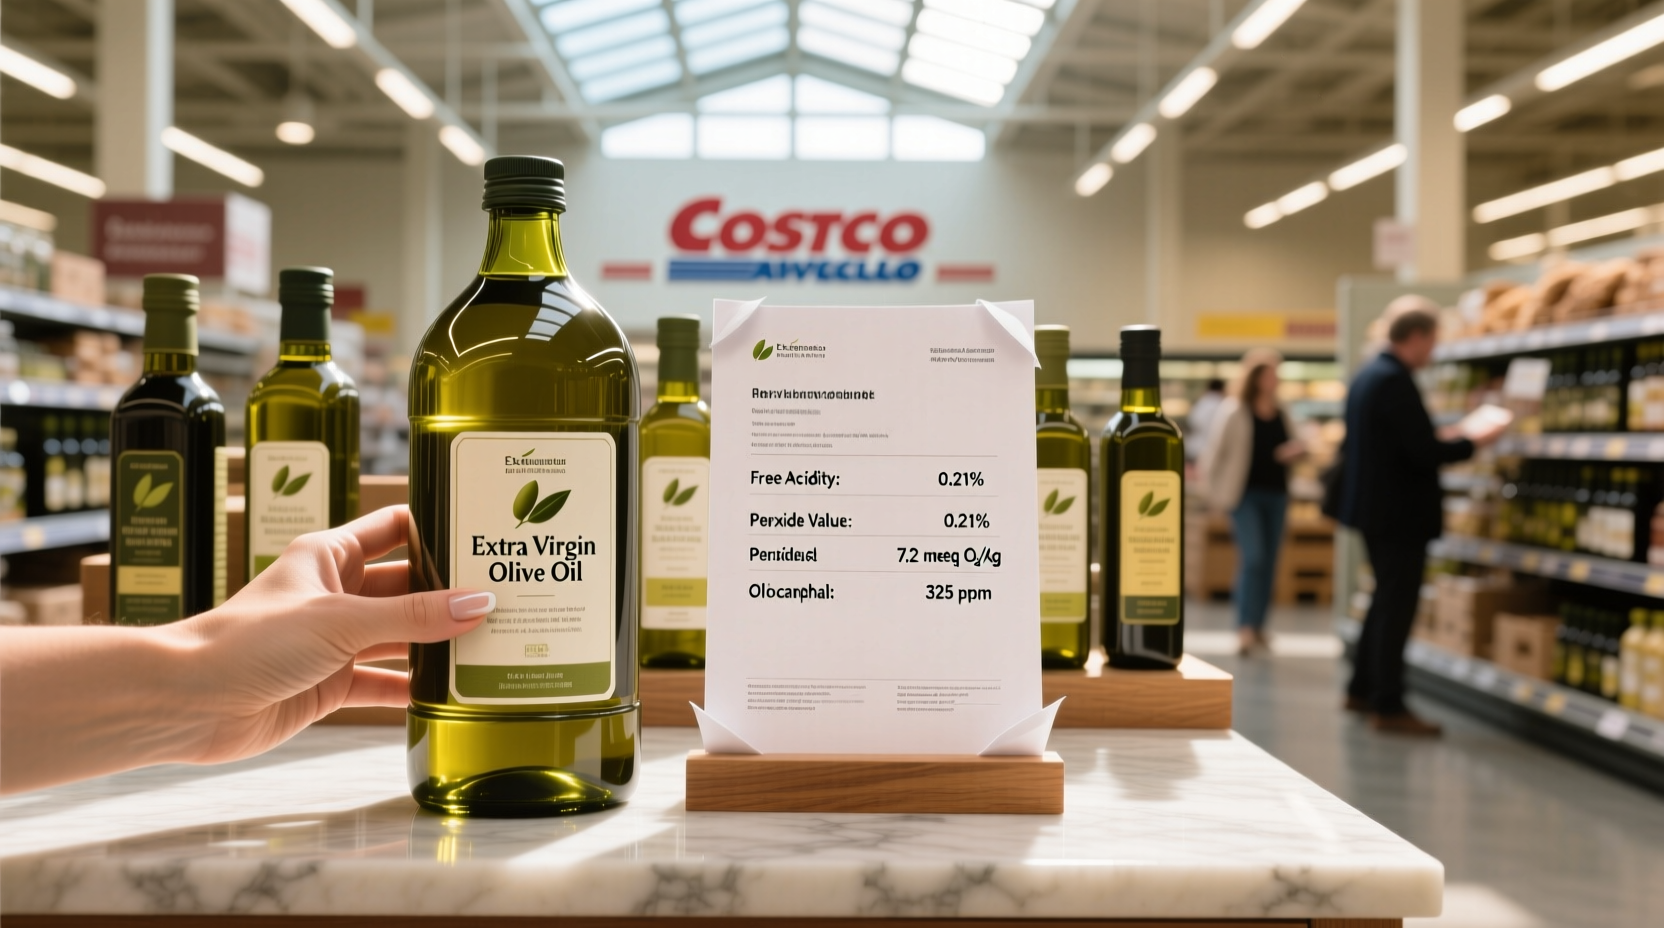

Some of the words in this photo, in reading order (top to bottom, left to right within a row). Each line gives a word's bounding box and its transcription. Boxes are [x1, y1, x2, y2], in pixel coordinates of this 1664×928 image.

[750, 470, 783, 486] Free
[784, 470, 841, 489] Acidity:
[938, 471, 985, 487] 0.21%
[807, 512, 853, 528] Value:
[943, 512, 990, 529] 0.21%
[471, 535, 528, 557] Extra
[532, 535, 596, 560] Virgin
[896, 547, 919, 564] 7.2
[488, 560, 546, 583] Olive
[550, 559, 583, 582] Oil
[925, 584, 954, 600] 325
[958, 588, 992, 605] ppm
